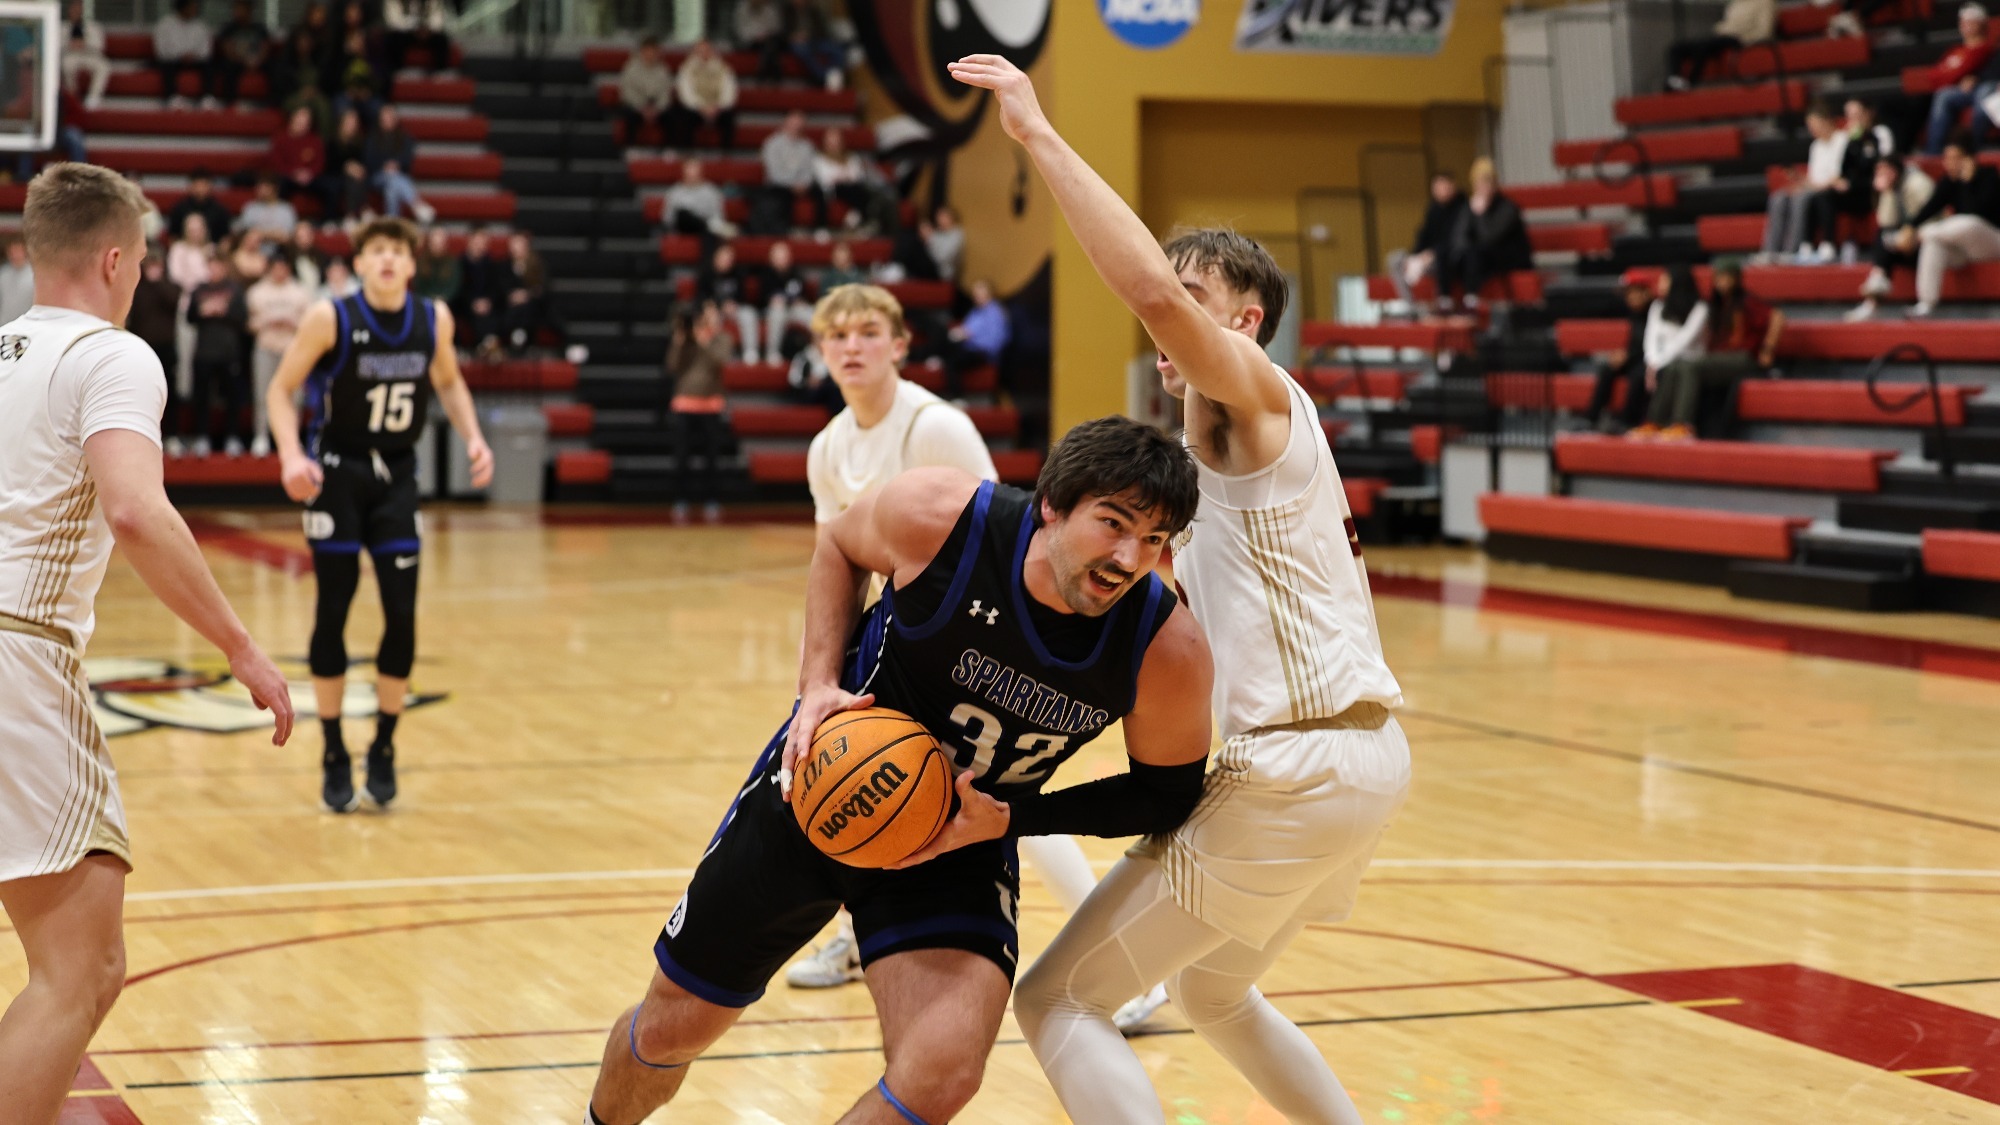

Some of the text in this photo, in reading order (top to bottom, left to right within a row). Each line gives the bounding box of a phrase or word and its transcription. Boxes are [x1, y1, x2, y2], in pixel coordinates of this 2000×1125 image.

[366, 382, 416, 433] 15
[952, 649, 1109, 734] SPARTANS
[803, 734, 849, 792] EVO
[940, 702, 1069, 785] 32
[816, 761, 909, 840] Wilson
